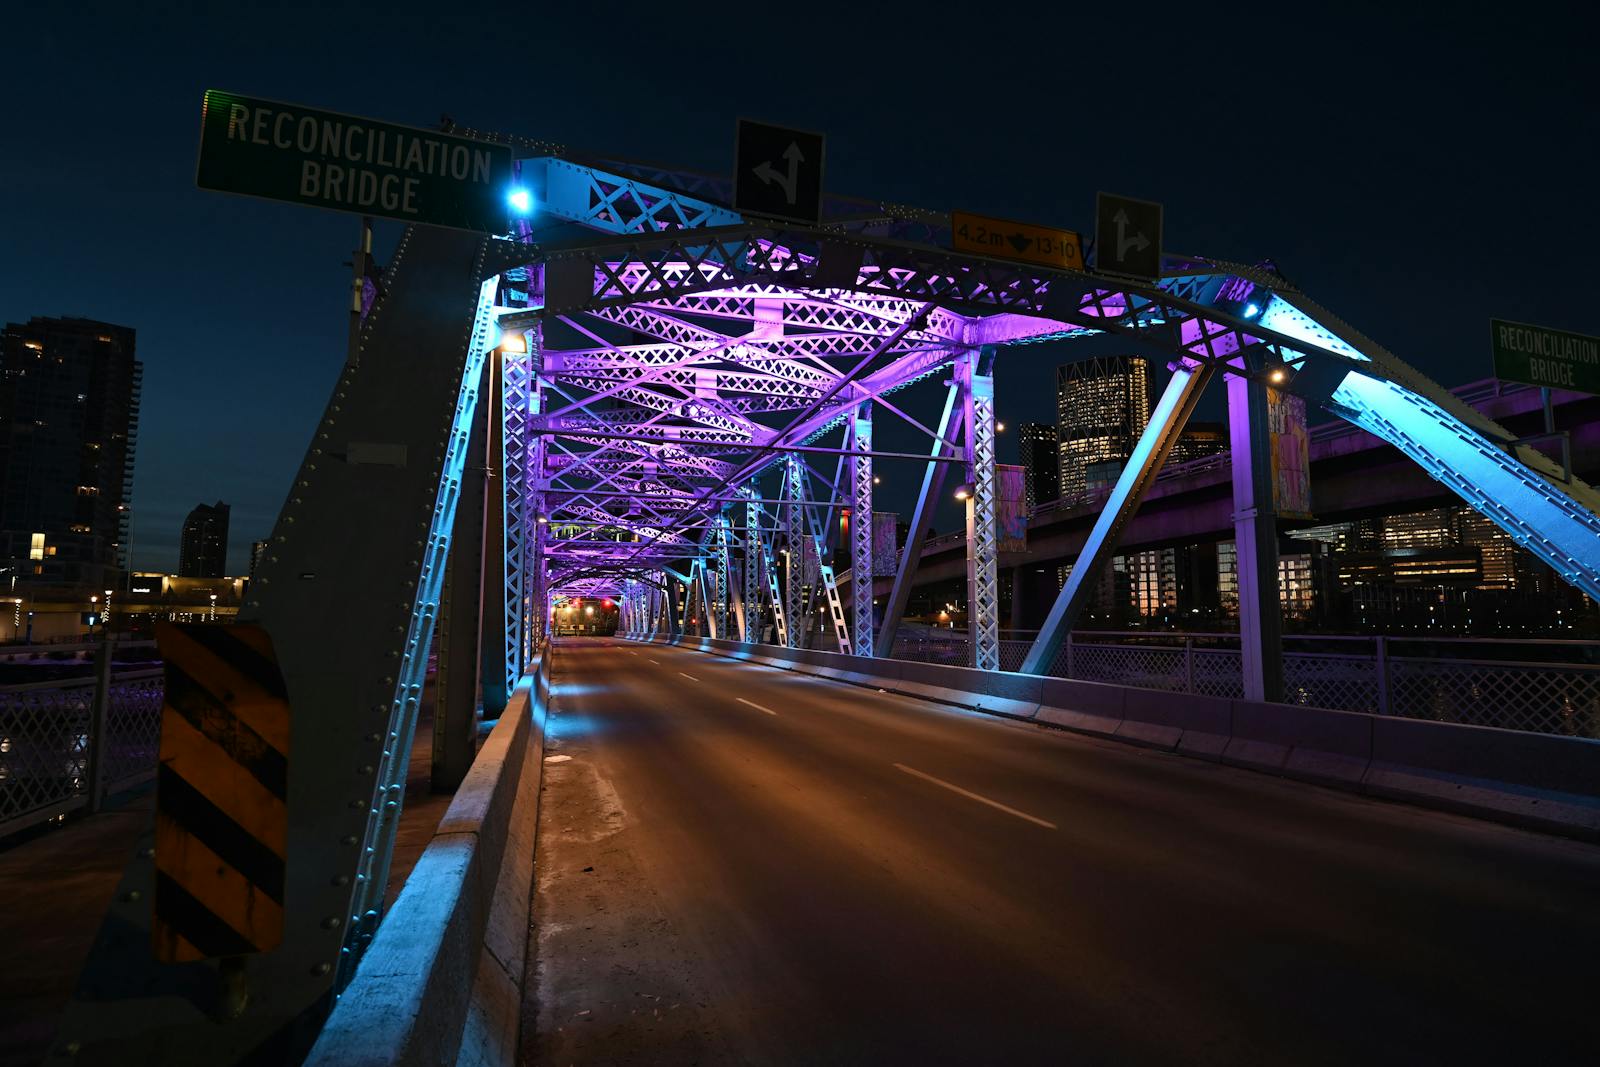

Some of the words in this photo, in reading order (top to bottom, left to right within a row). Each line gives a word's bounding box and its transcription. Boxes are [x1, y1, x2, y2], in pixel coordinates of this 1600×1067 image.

[227, 103, 492, 185] RECONCILIATION
[300, 160, 421, 214] BRIDGE
[958, 223, 1004, 247] 4.2m
[1500, 326, 1599, 365] RECONCILIATION
[1530, 358, 1575, 386] BRIDGE
